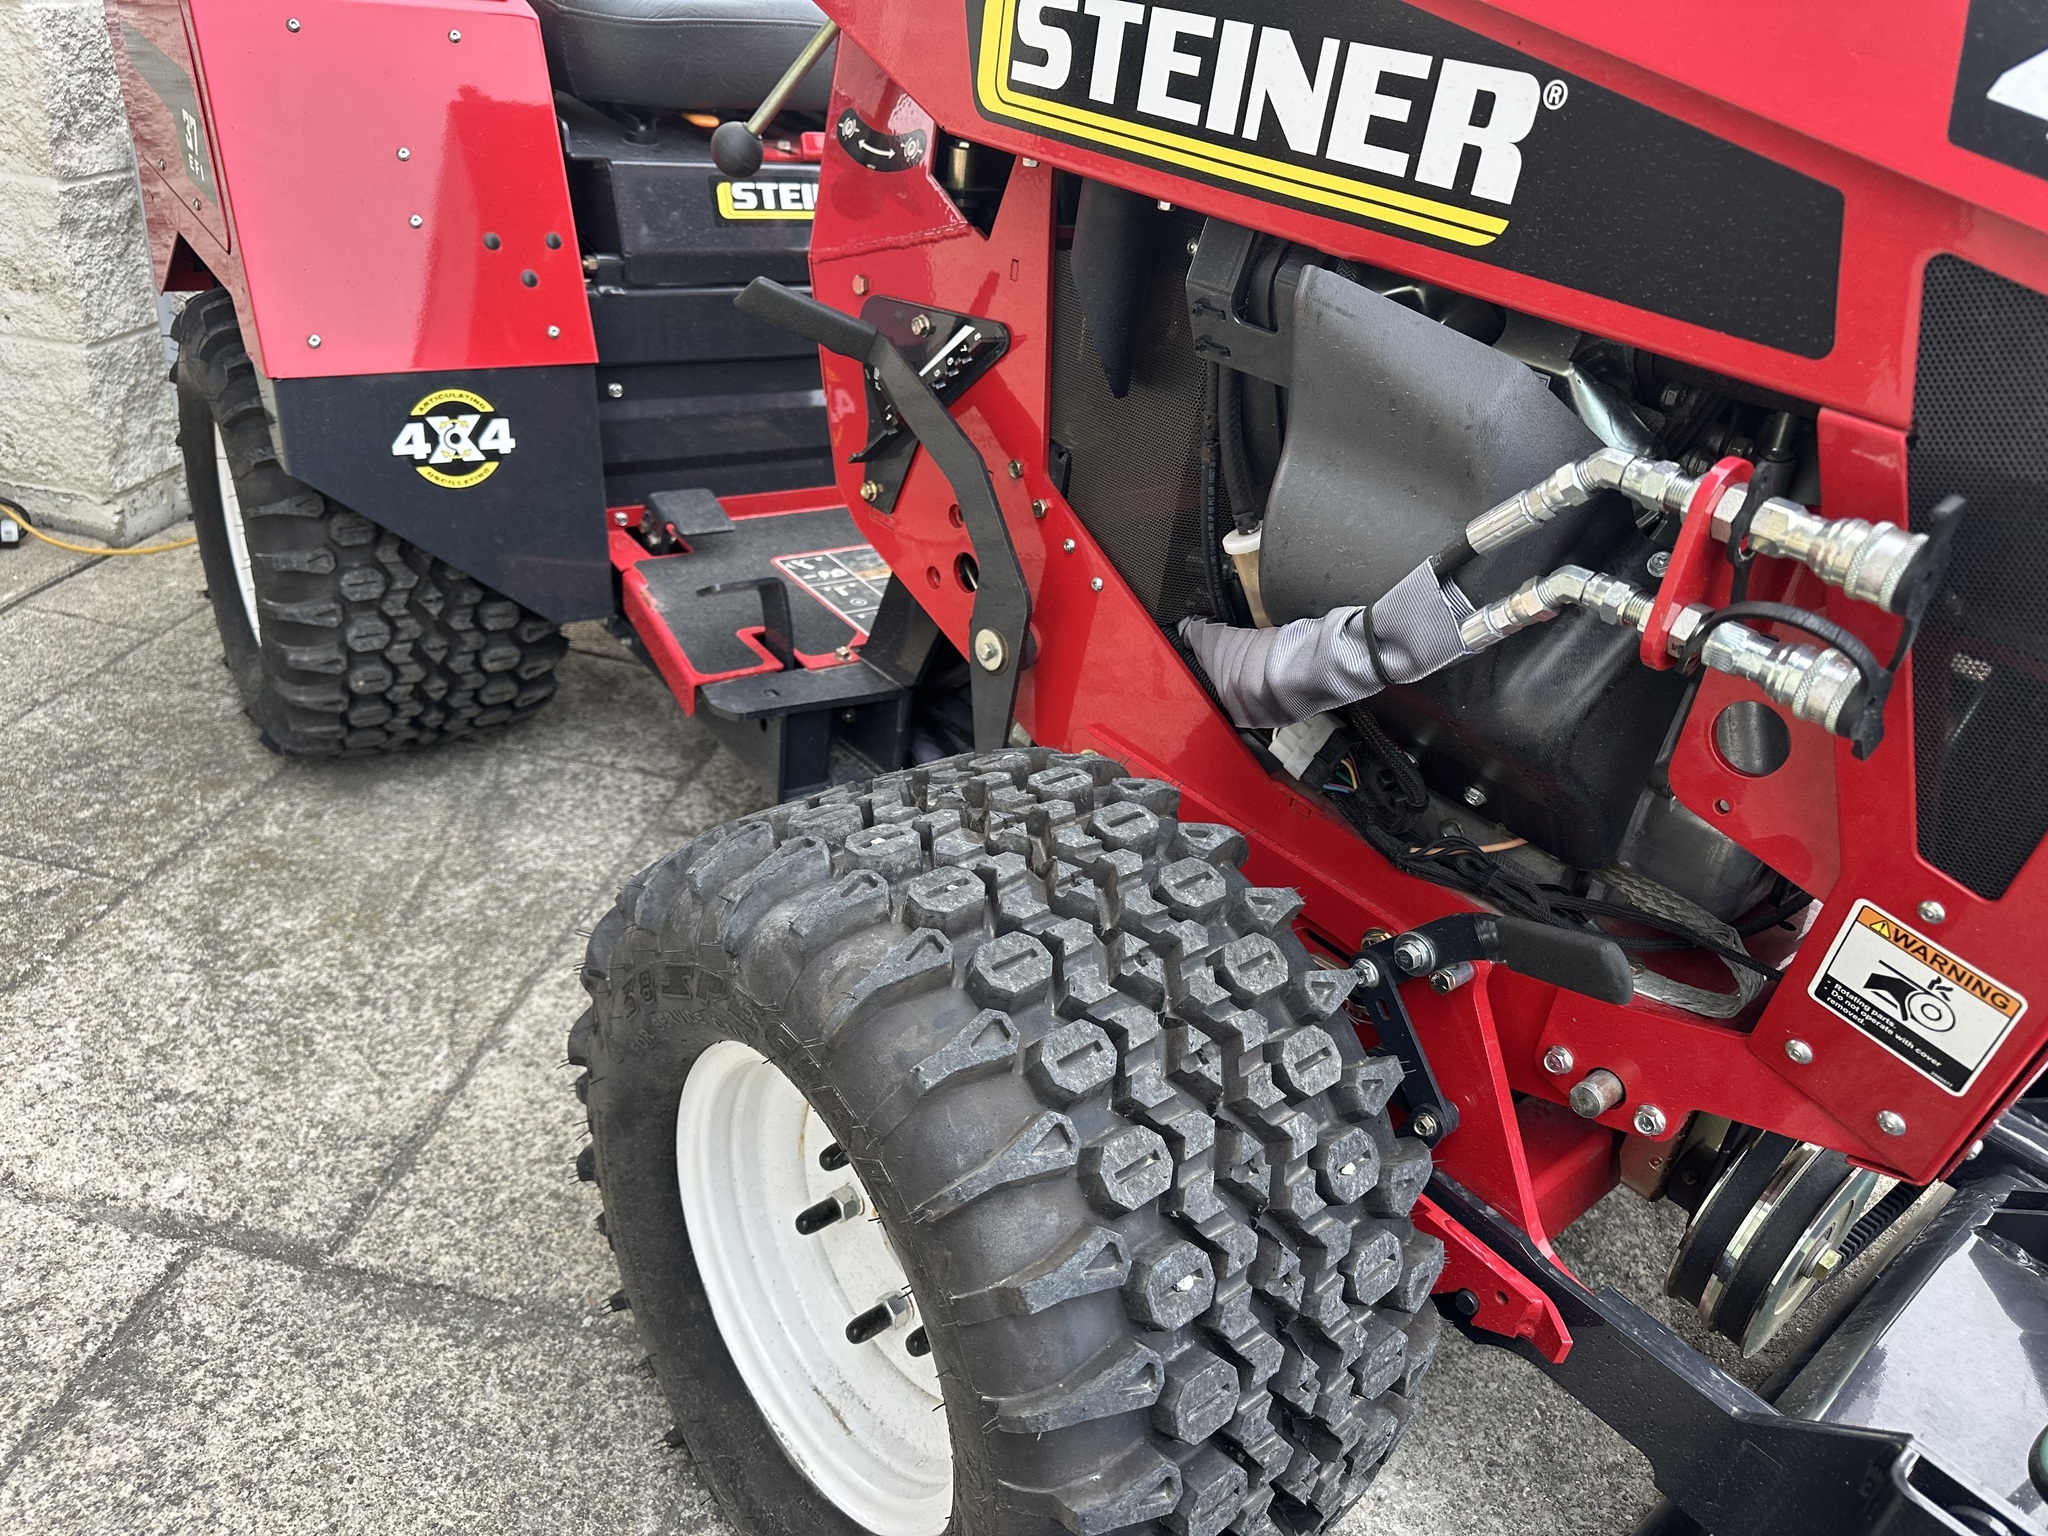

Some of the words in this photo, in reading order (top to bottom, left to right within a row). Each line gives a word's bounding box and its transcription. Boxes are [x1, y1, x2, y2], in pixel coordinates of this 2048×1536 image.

[182, 108, 199, 155] 37
[188, 153, 205, 181] EFI
[731, 182, 819, 210] STEI
[419, 392, 486, 412] ARTICULATING
[427, 467, 490, 486] OSCILLATING
[1892, 928, 2010, 1010] WARNING
[652, 1009, 706, 1031] SERVICE
[1827, 996, 1865, 1026] removed.
[1834, 983, 1871, 1012] Rotating
[1871, 1009, 1896, 1029] parts.
[1831, 990, 1844, 1001] Do
[1845, 1000, 1860, 1012] not
[1860, 1010, 1894, 1035] operate
[1895, 1033, 1914, 1049] with
[1915, 1048, 1942, 1067] cover
